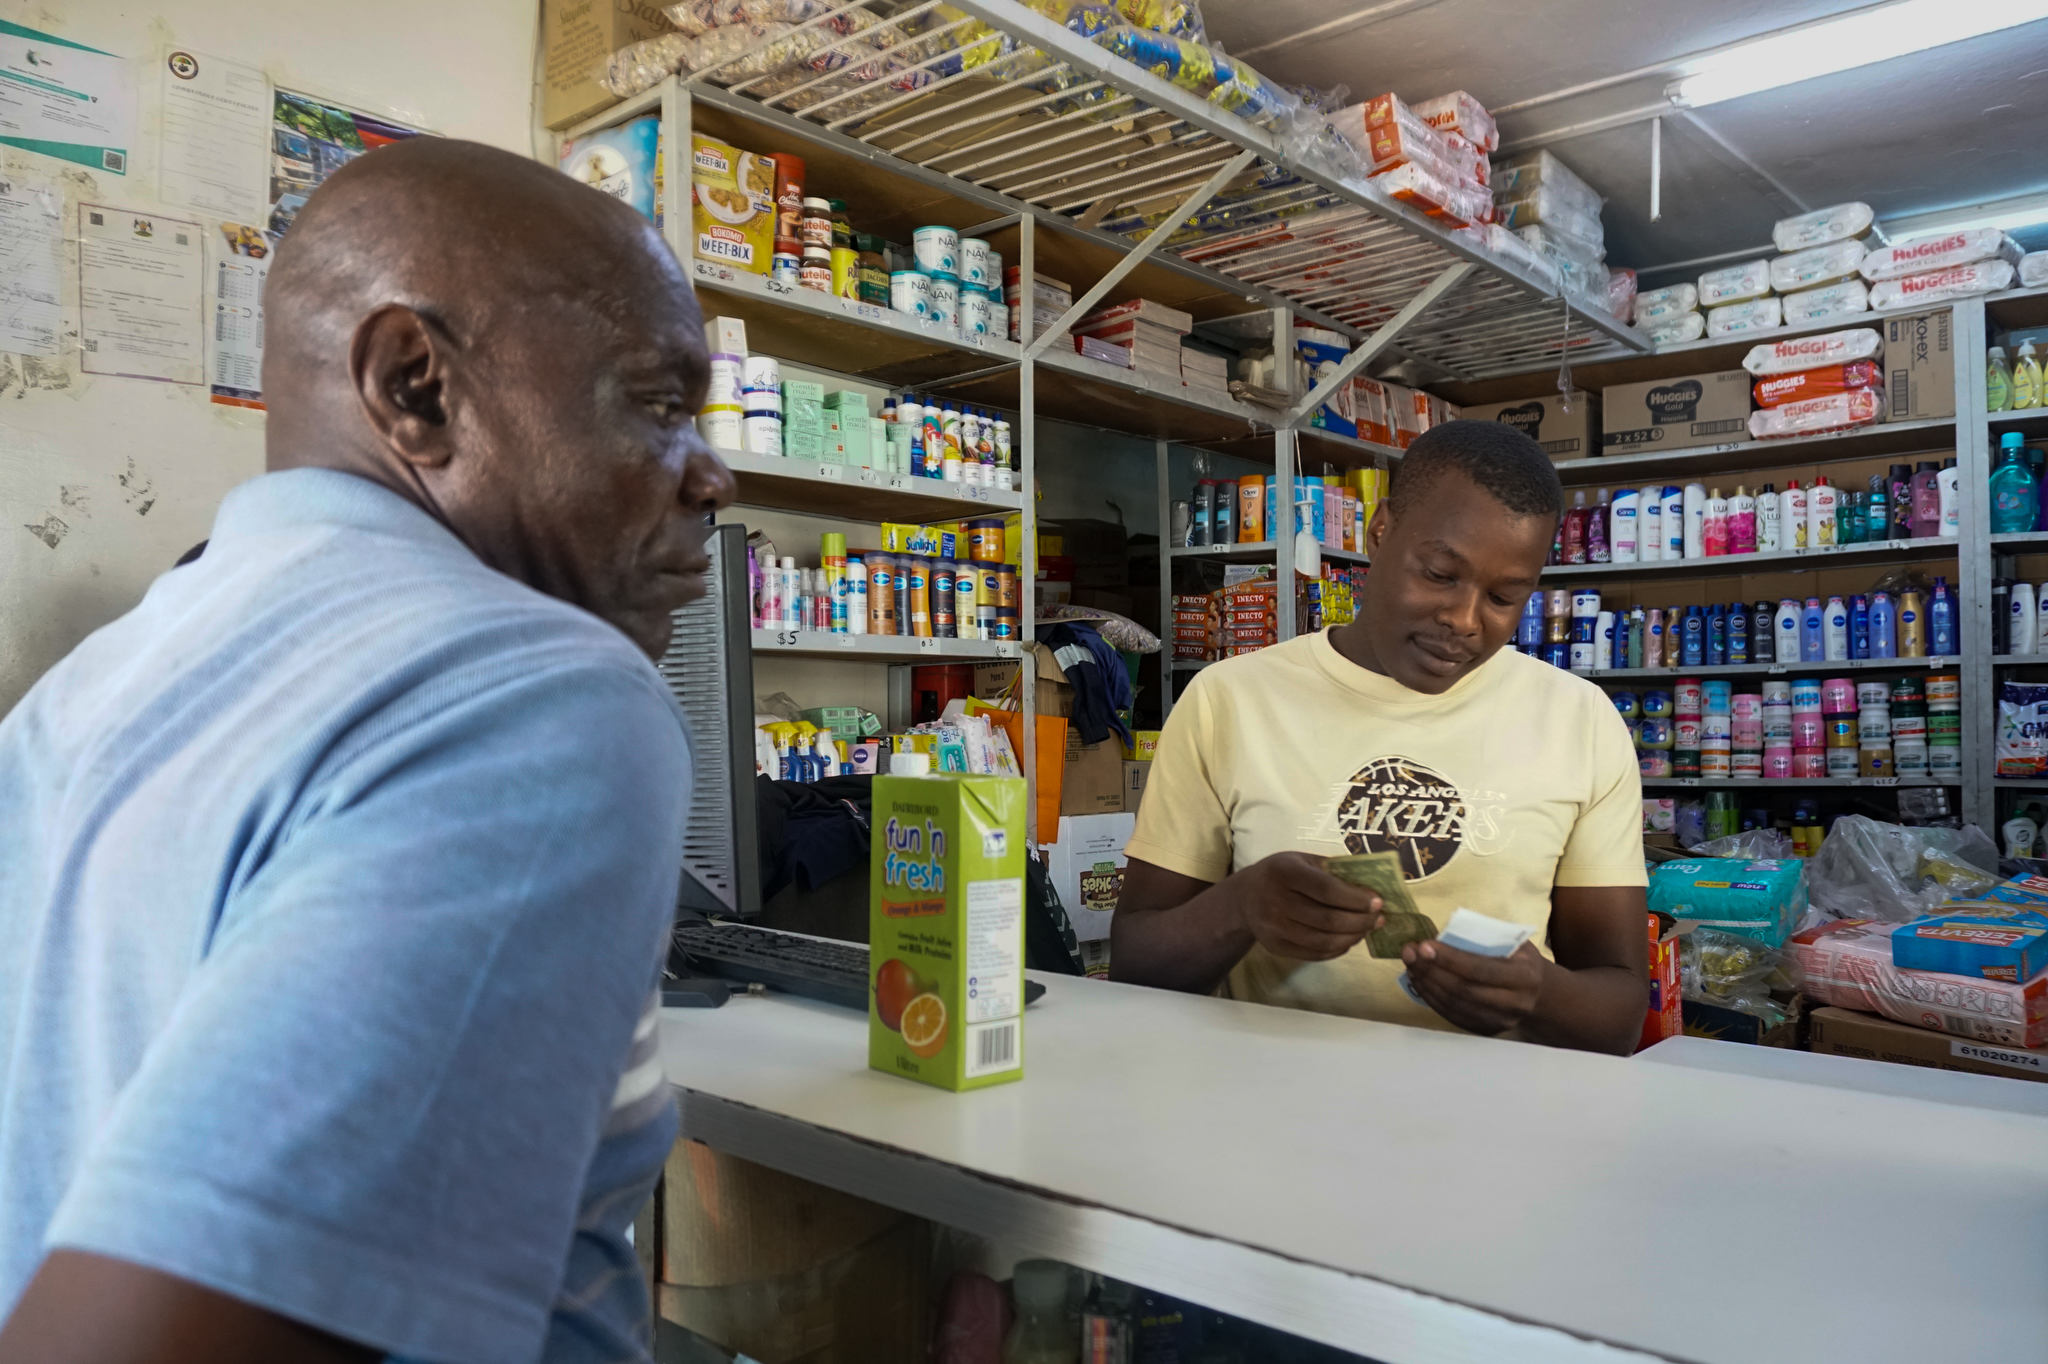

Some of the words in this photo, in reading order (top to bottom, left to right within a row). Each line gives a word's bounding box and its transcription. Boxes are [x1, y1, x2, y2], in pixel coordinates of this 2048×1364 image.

[803, 221, 830, 233] utella
[712, 228, 743, 242] BOKOMO
[701, 237, 750, 260] WEET-BIX
[1893, 234, 1967, 262] HUGGIES
[1901, 268, 1976, 293] HUGGIES
[1761, 375, 1806, 393] HUGGIES
[1651, 391, 1697, 405] HUGGIES
[1665, 402, 1683, 411] Gold
[1501, 412, 1540, 424] HUGGIES
[1615, 433, 1622, 443] 2
[1625, 435, 1631, 443] x
[1634, 431, 1648, 442] 52
[906, 536, 938, 553] Sunlight
[1225, 585, 1241, 595] INEC
[1182, 596, 1208, 604] INECTO
[1237, 595, 1264, 603] INECTO
[1180, 613, 1205, 621] INECTO
[1237, 612, 1263, 620] INECTO
[777, 631, 800, 645] $5
[1237, 629, 1263, 637] INECTO
[1178, 646, 1204, 654] INECTO
[1367, 783, 1409, 797] LOS
[1408, 785, 1507, 800] ANGELES
[1297, 782, 1507, 857] LAKERS
[886, 817, 921, 853] fun
[926, 819, 945, 856] 'n
[885, 852, 944, 892] fresh
[1916, 927, 2024, 941] CEREVITA
[1960, 1045, 2041, 1067] 61020274
